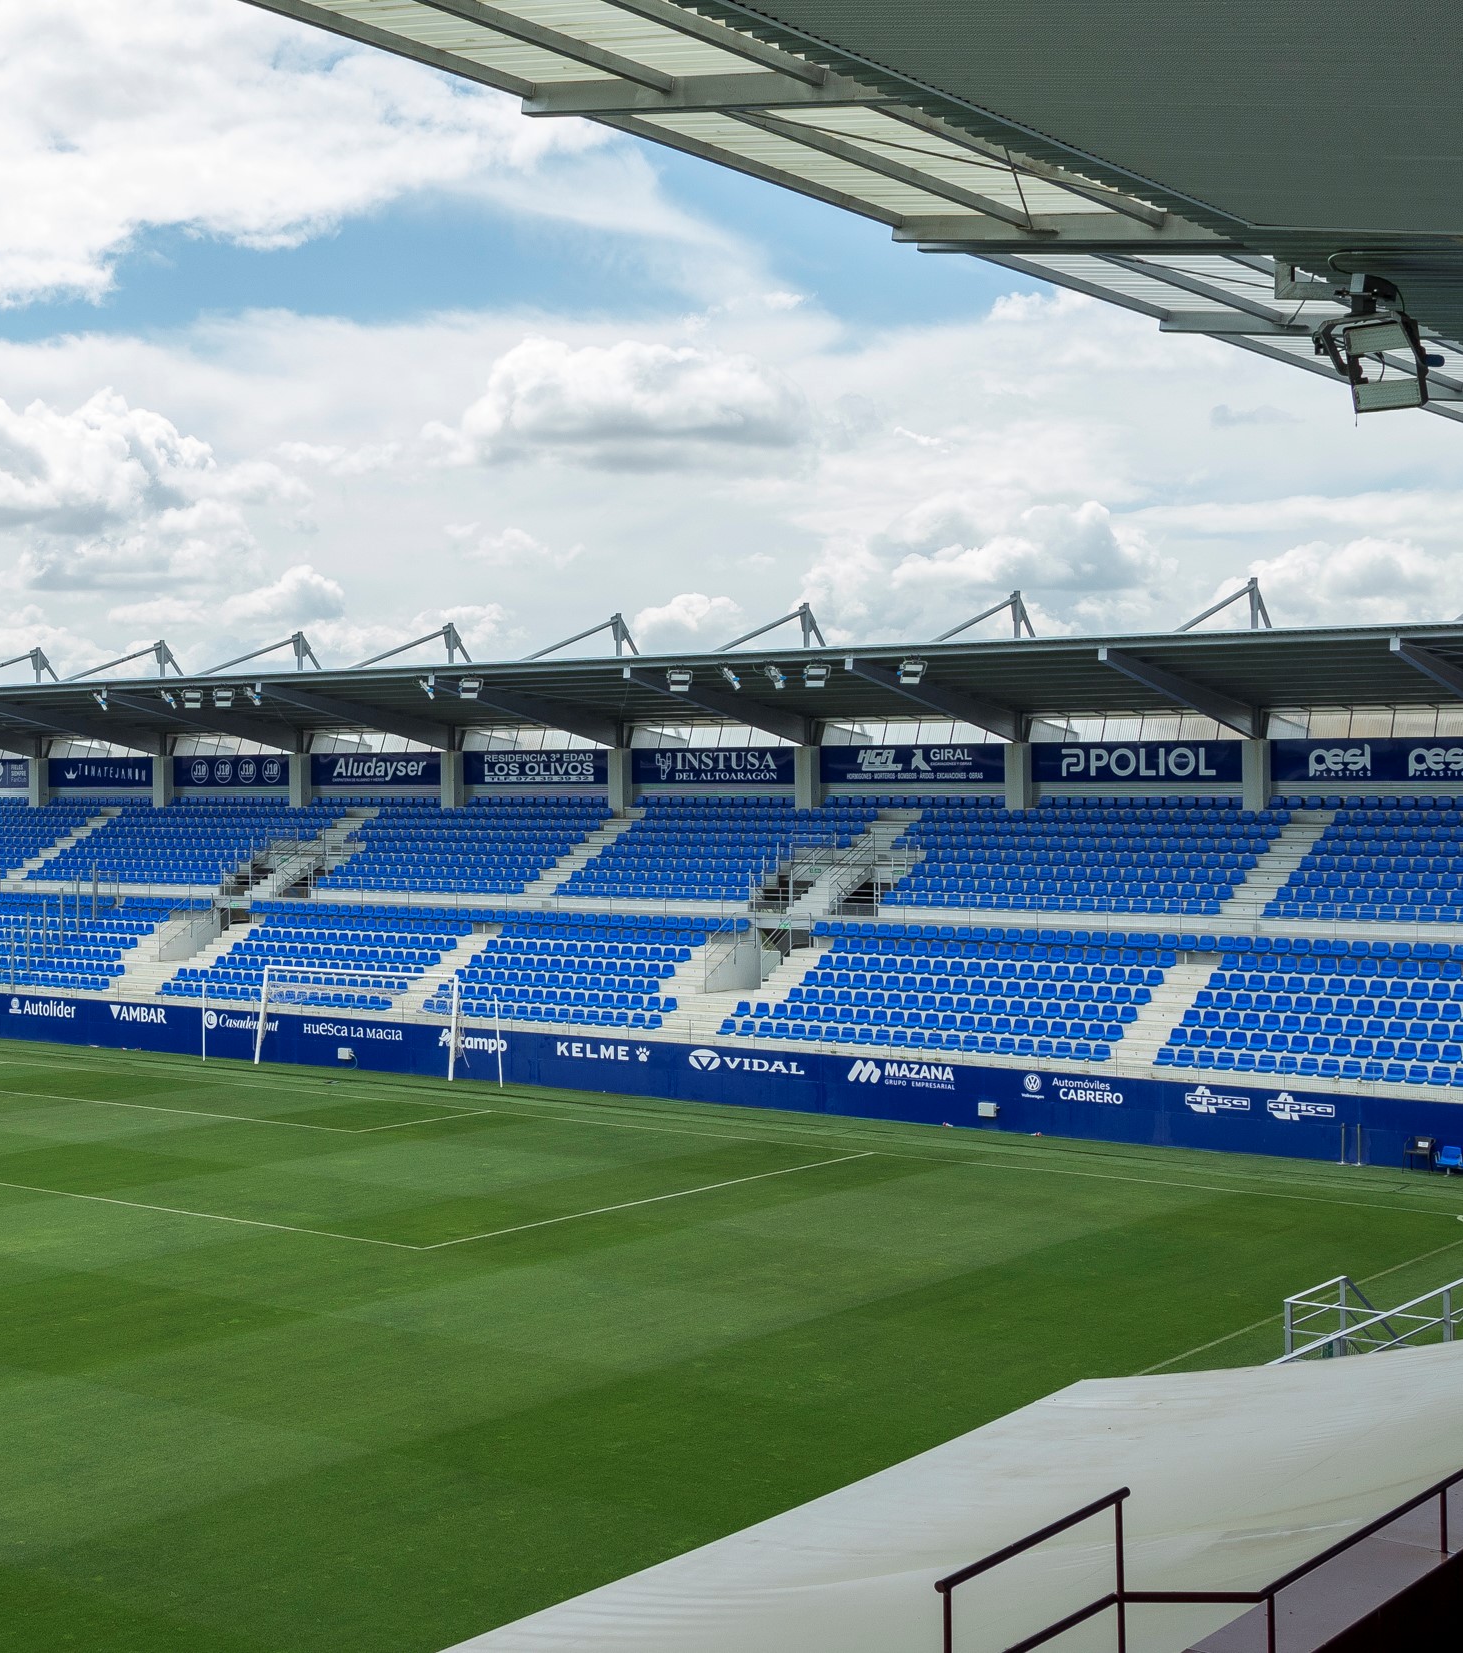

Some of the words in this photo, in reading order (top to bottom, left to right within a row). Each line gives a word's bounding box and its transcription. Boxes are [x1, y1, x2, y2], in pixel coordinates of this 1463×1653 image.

[484, 754, 548, 762] RESIDENCIA
[563, 753, 594, 761] EDAD
[675, 751, 777, 770] INSTUSA
[930, 748, 973, 761] GIRAL
[1089, 747, 1217, 777] POLIOL
[333, 757, 427, 781] Aludayser
[484, 763, 520, 775] LOS
[525, 762, 595, 775] OLIVOS
[675, 772, 697, 781] DEL
[699, 770, 777, 781] ALTOARAGÓN
[23, 1000, 76, 1018] Autolíder
[120, 1005, 167, 1024] AMBAR
[556, 1041, 630, 1061] KELME
[722, 1056, 805, 1075] VIDAL
[884, 1062, 955, 1081] MAZANA
[884, 1079, 907, 1087] GRUPO
[911, 1080, 955, 1090] EMPRESARIAL
[1052, 1077, 1111, 1090] Automóviles
[1059, 1088, 1124, 1105] CABRERO
